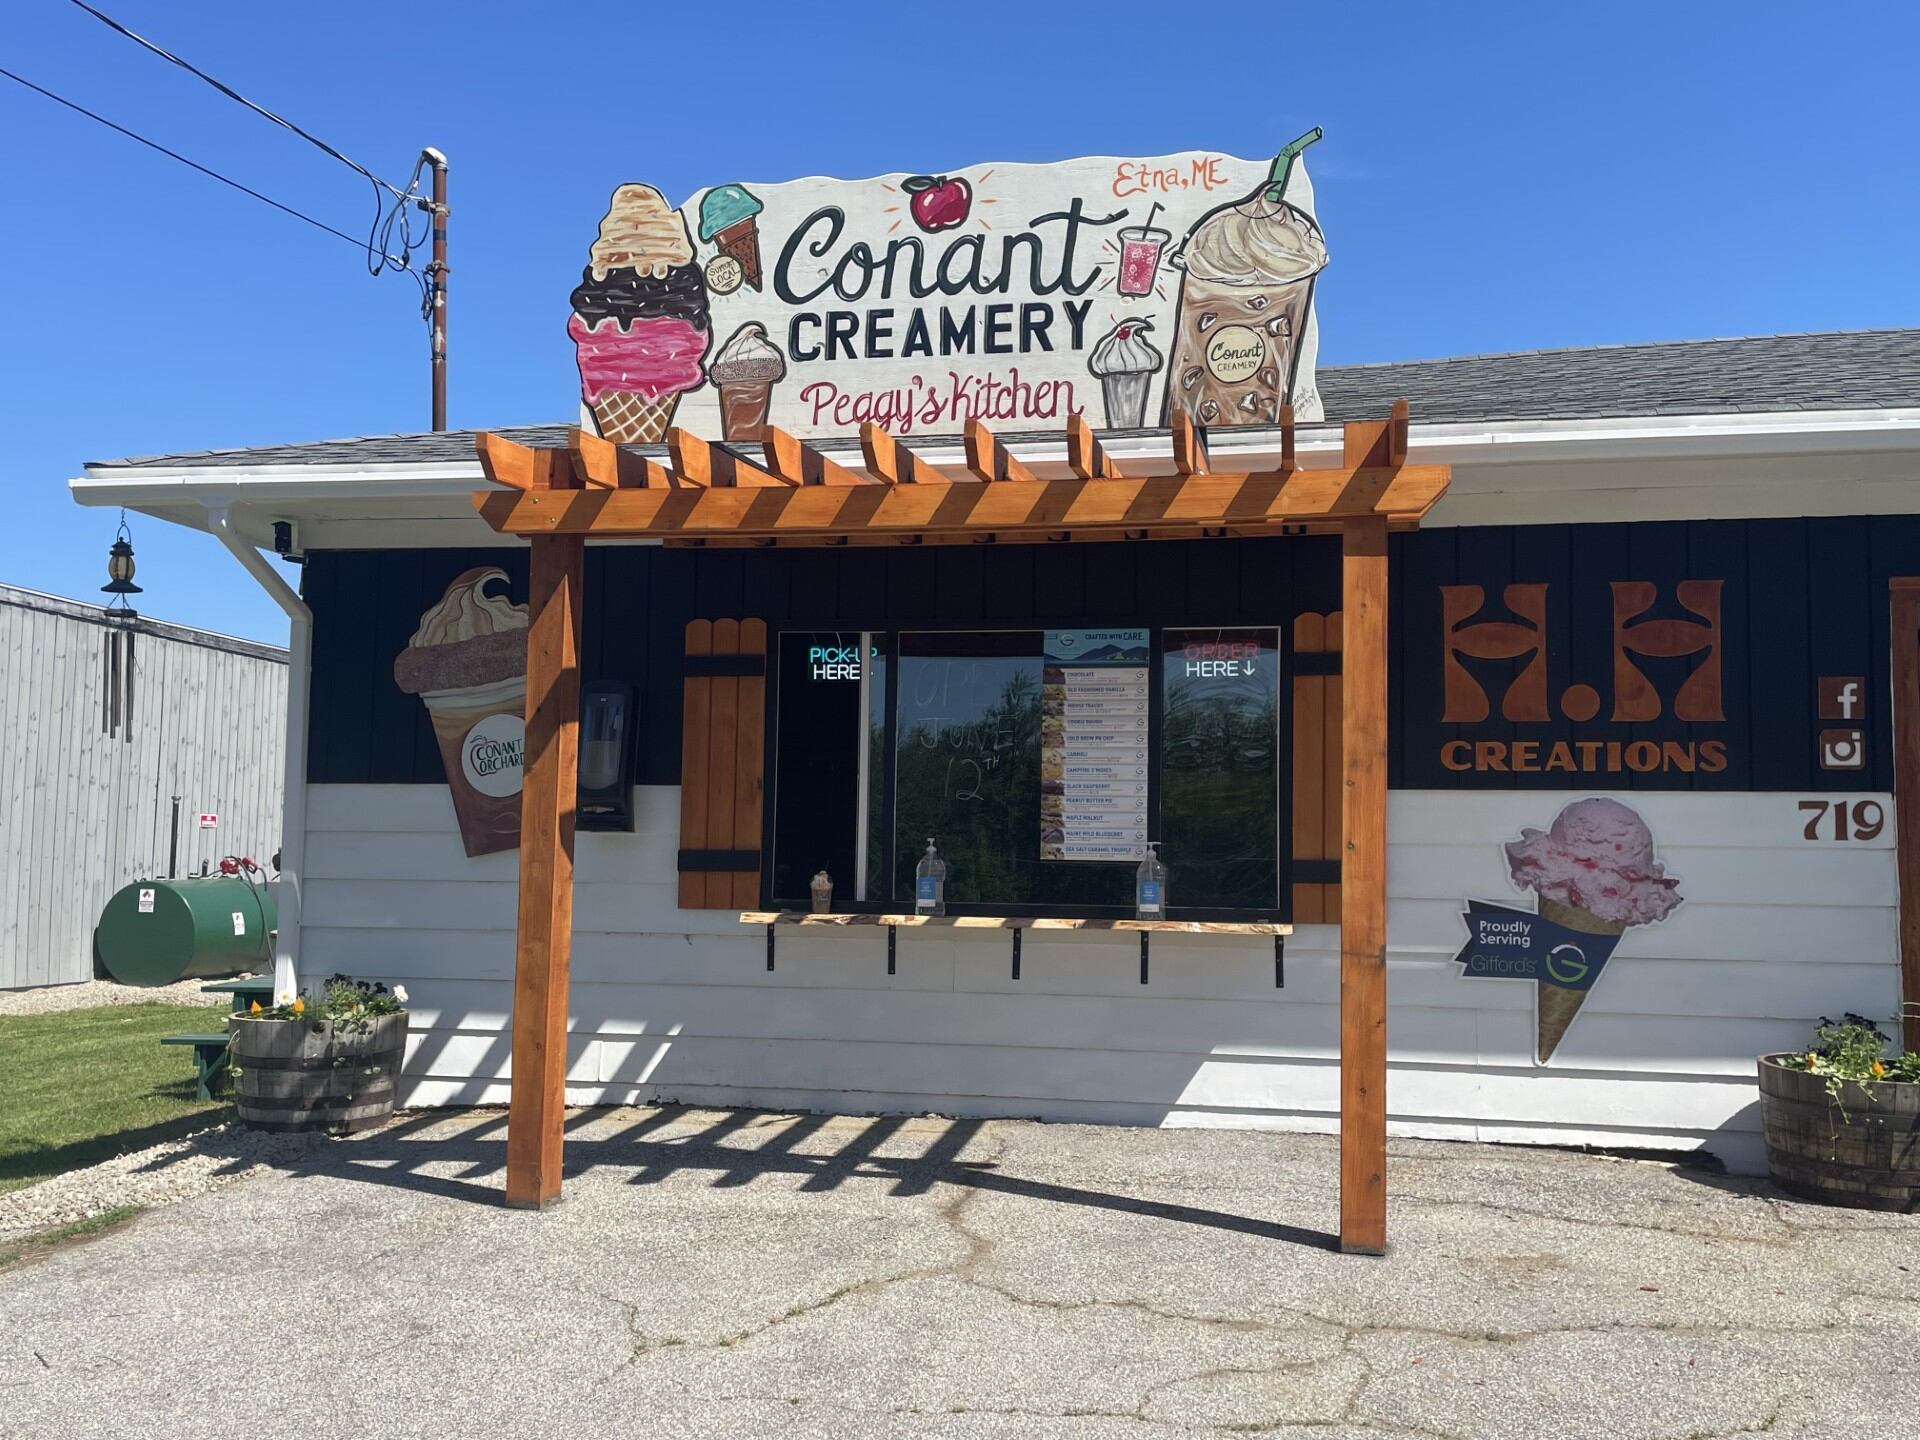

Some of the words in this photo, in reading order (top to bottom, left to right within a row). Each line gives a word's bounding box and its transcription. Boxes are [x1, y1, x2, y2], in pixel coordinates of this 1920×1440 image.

[1112, 162, 1189, 198] Etna,
[1191, 156, 1229, 192] ME
[773, 197, 1130, 305] Conant
[788, 299, 1095, 363] CREAMERY
[1210, 341, 1263, 362] Conant
[1216, 359, 1258, 372] CREAMERY
[947, 366, 1085, 422] Kitchen
[1184, 642, 1259, 660] ORDER
[813, 664, 861, 680] HERE
[1186, 660, 1239, 678] HERE
[476, 738, 523, 761] CONANT
[1440, 740, 1729, 773] CREATIONS
[1798, 800, 1885, 841] 719
[1479, 920, 1532, 935] Proudly
[1479, 933, 1531, 949] Serving
